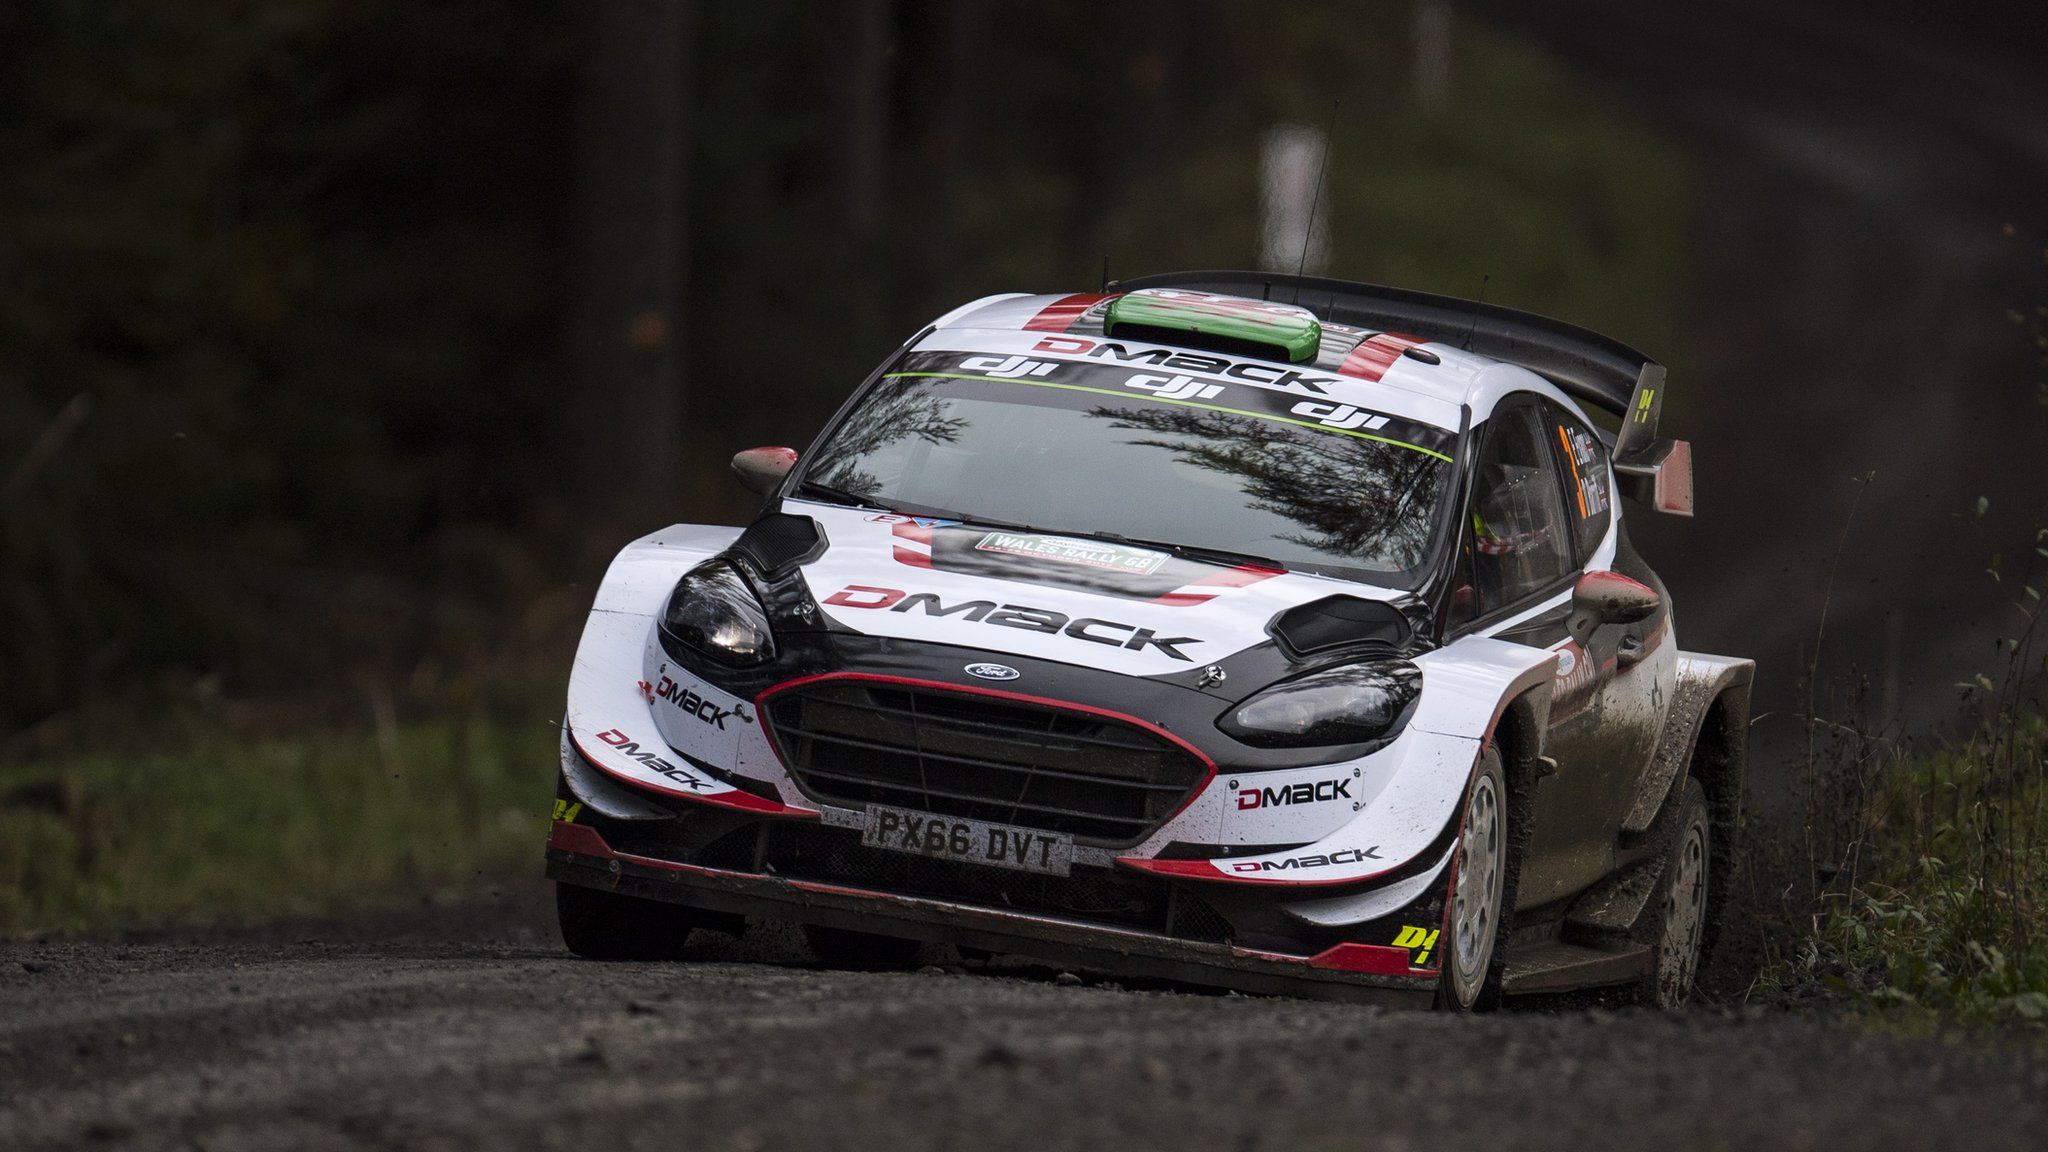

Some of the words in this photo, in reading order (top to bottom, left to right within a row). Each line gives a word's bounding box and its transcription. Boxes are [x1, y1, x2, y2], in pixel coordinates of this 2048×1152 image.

[994, 535, 1057, 556] WALES
[1063, 546, 1124, 565] RALLY
[1124, 556, 1152, 569] GB
[877, 810, 971, 856] PX66
[986, 828, 1057, 868] DVT
